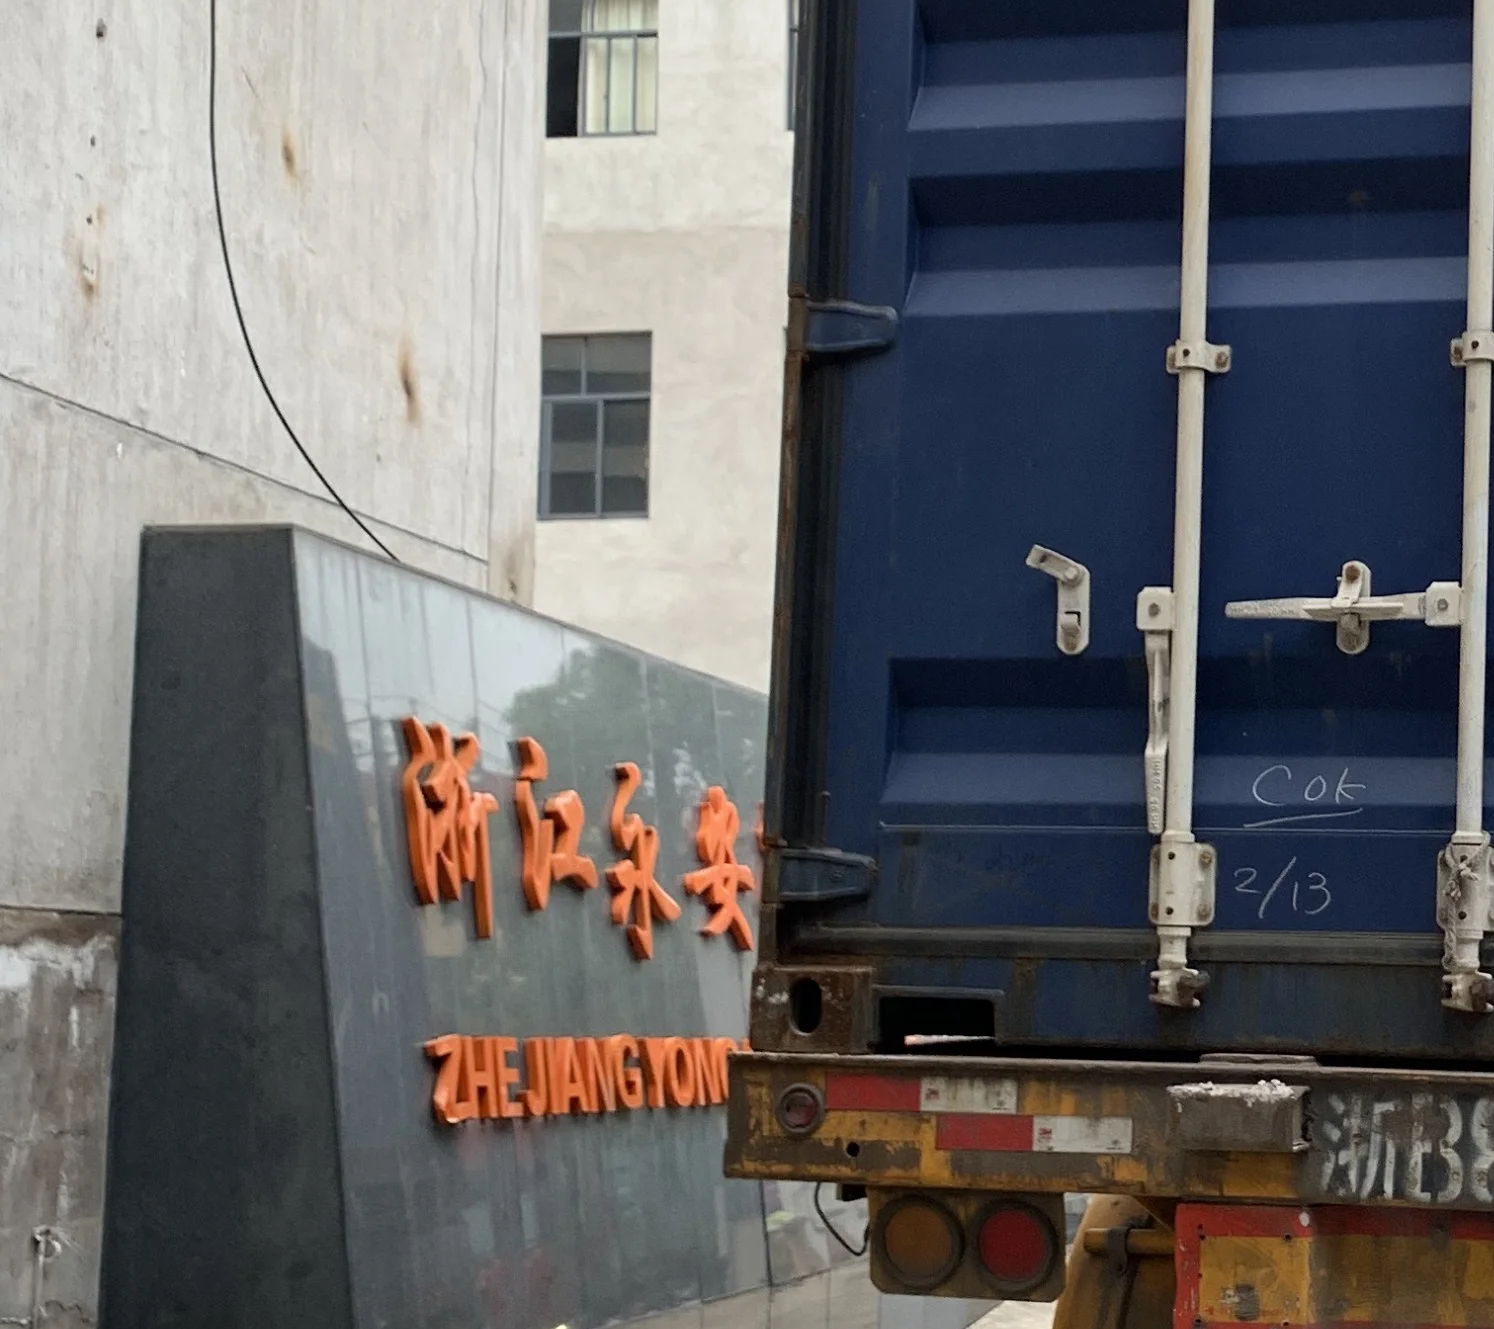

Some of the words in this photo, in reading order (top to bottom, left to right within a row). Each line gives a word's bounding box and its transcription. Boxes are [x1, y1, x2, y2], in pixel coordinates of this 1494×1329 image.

[401, 716, 765, 960] 浙江永安
[1233, 855, 1332, 919] 2/13
